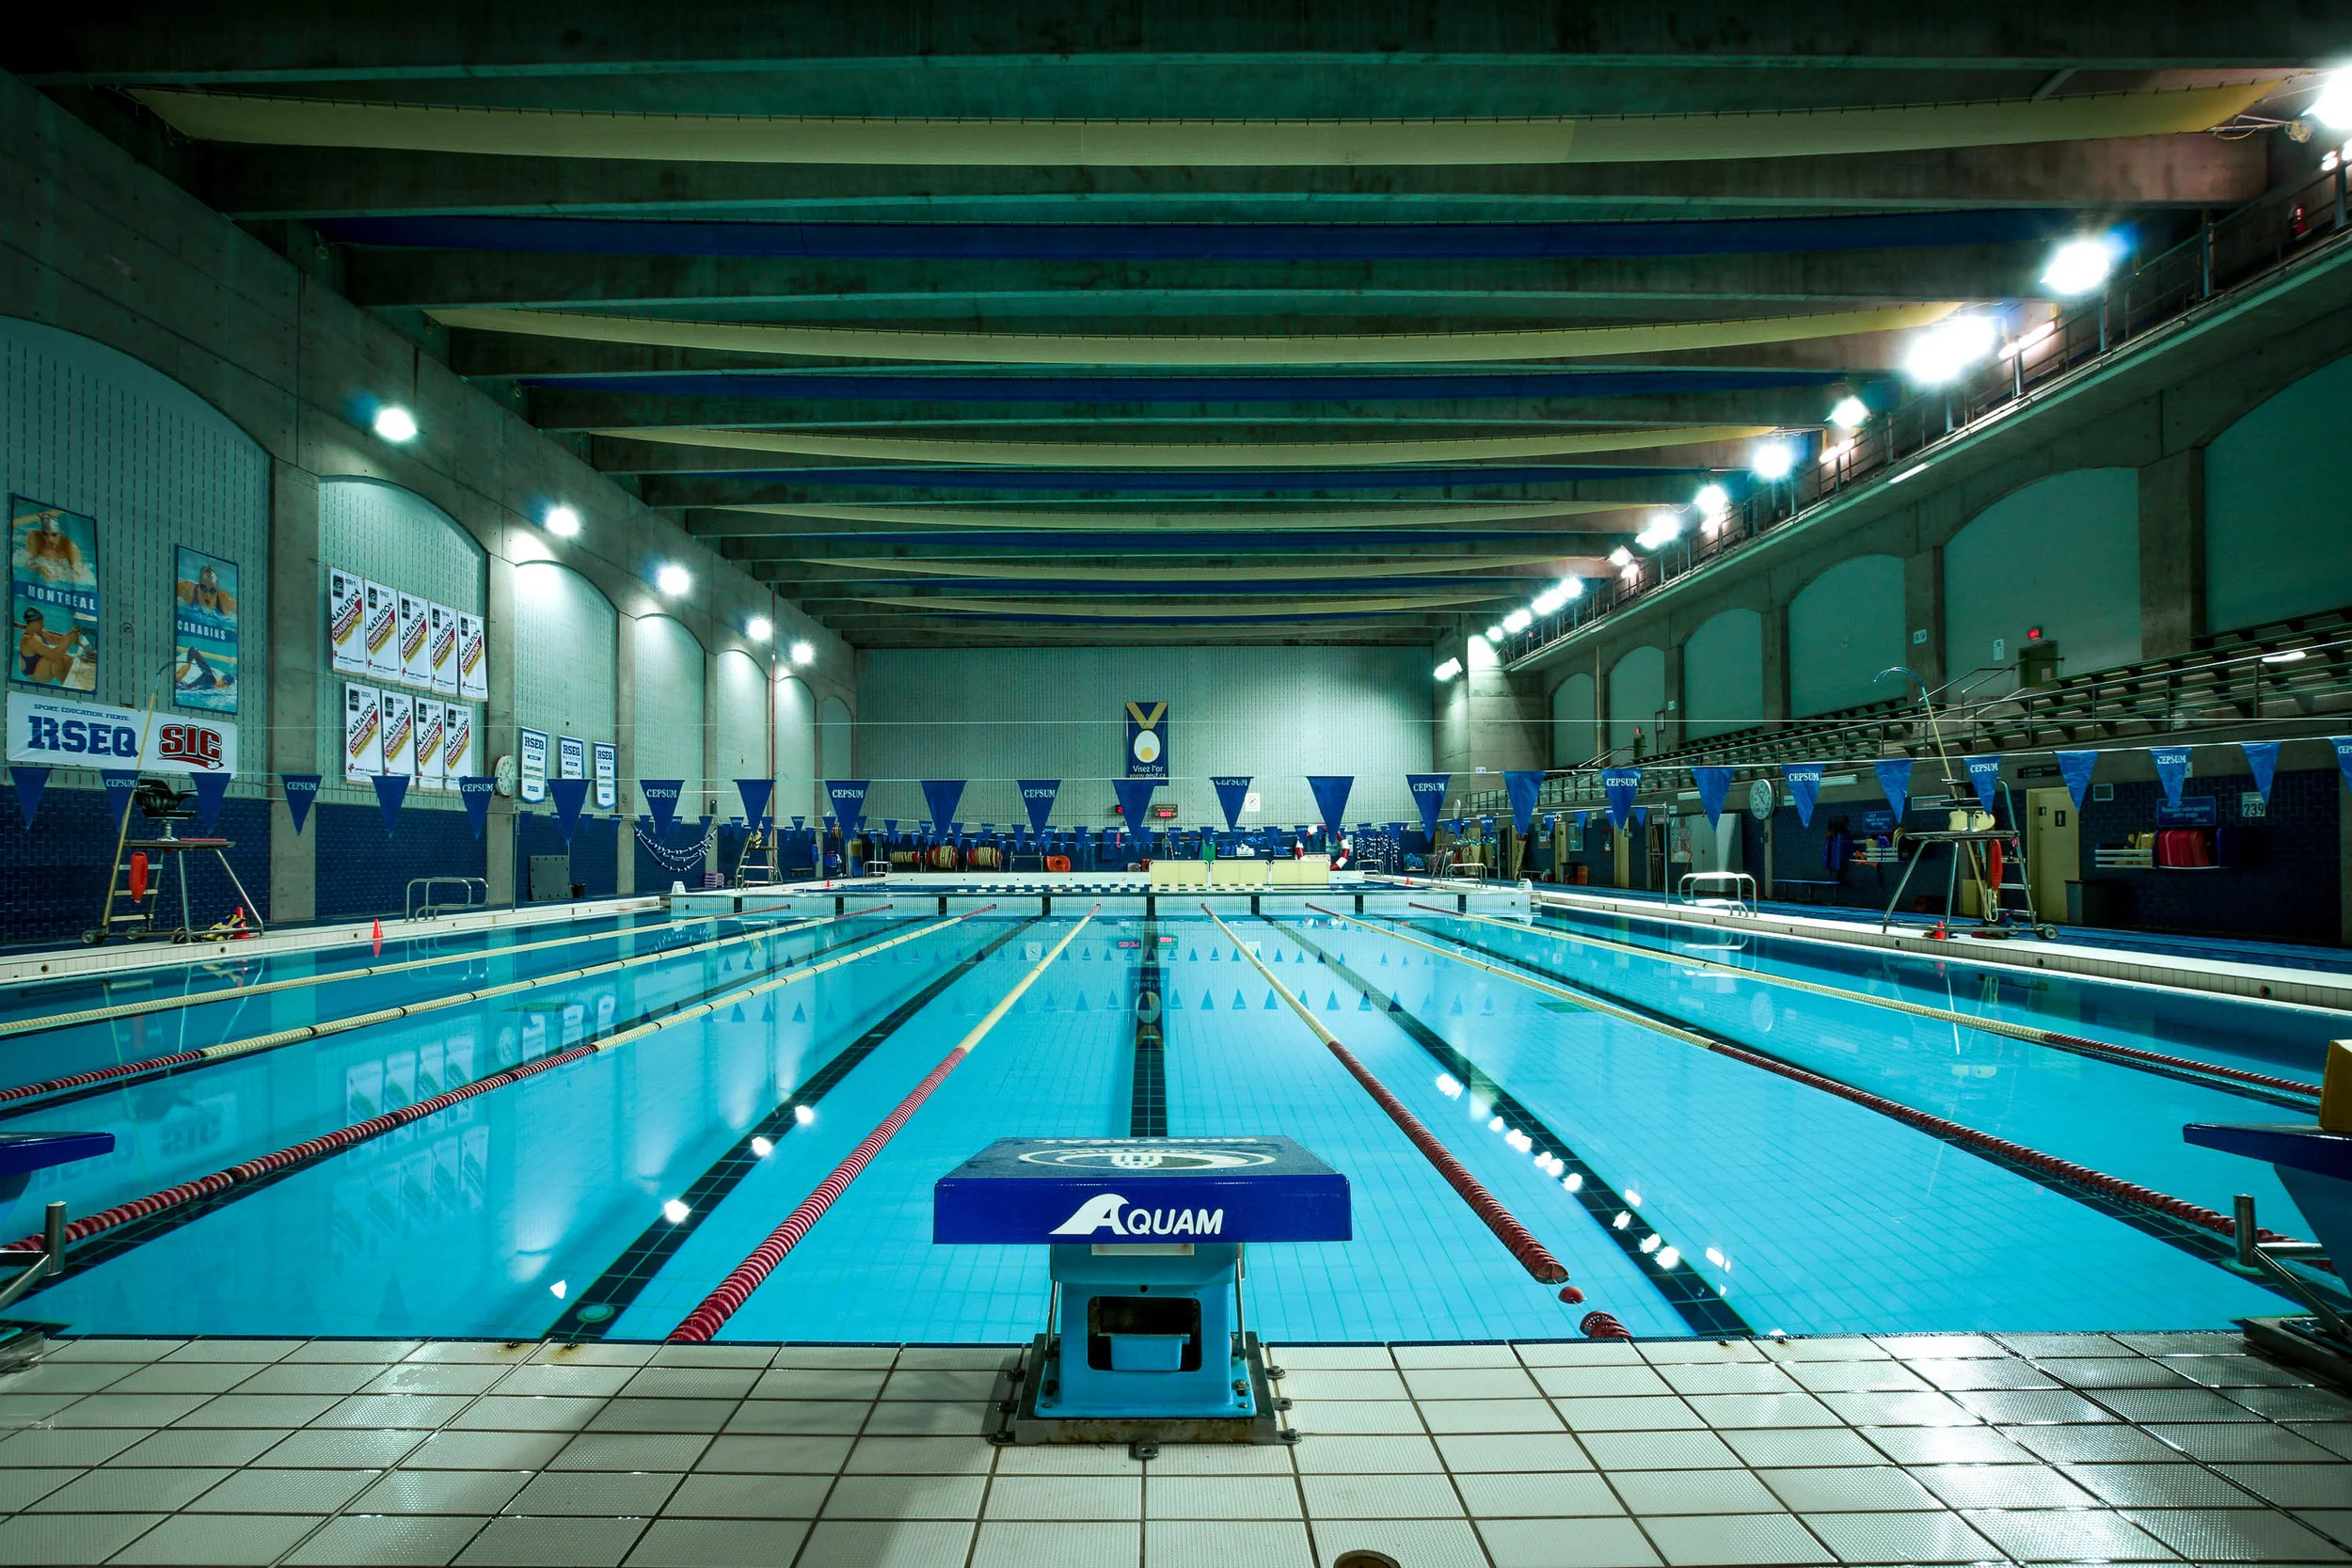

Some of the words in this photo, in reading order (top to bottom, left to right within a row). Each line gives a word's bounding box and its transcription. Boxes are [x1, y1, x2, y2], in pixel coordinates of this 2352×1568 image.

[28, 585, 96, 610] MONTRÉAL
[332, 589, 360, 623] NATATION
[367, 602, 393, 634] NATATION
[177, 620, 226, 641] CARABINS
[402, 610, 425, 643] NATATION
[433, 620, 453, 651] NATATION
[461, 628, 481, 659] NATATION
[349, 700, 376, 737] NATATION
[385, 706, 409, 742] NATATION
[28, 715, 139, 757] RSEQ
[417, 713, 440, 748] NATATION
[446, 718, 469, 751] NATATION
[159, 723, 223, 761] SIC
[524, 736, 544, 750] RSEQ
[563, 745, 580, 756] RSEQ
[597, 751, 612, 760] RSEQ
[2157, 754, 2186, 764] CEPSUM
[1969, 763, 1998, 773] CEPSUM
[105, 779, 135, 788] CEPSUM
[1606, 778, 1637, 787] CEPSUM
[1788, 772, 1820, 782] CEPSUM
[287, 782, 316, 791] CEPSUM
[462, 784, 494, 792] CEPSUM
[646, 788, 677, 799] CEPSUM
[832, 788, 864, 799] CEPSUM
[1413, 783, 1445, 792] CEPSUM
[1024, 789, 1056, 799] CEPSUM
[2244, 802, 2265, 816] 239
[1048, 1193, 1224, 1235] AQUAM
